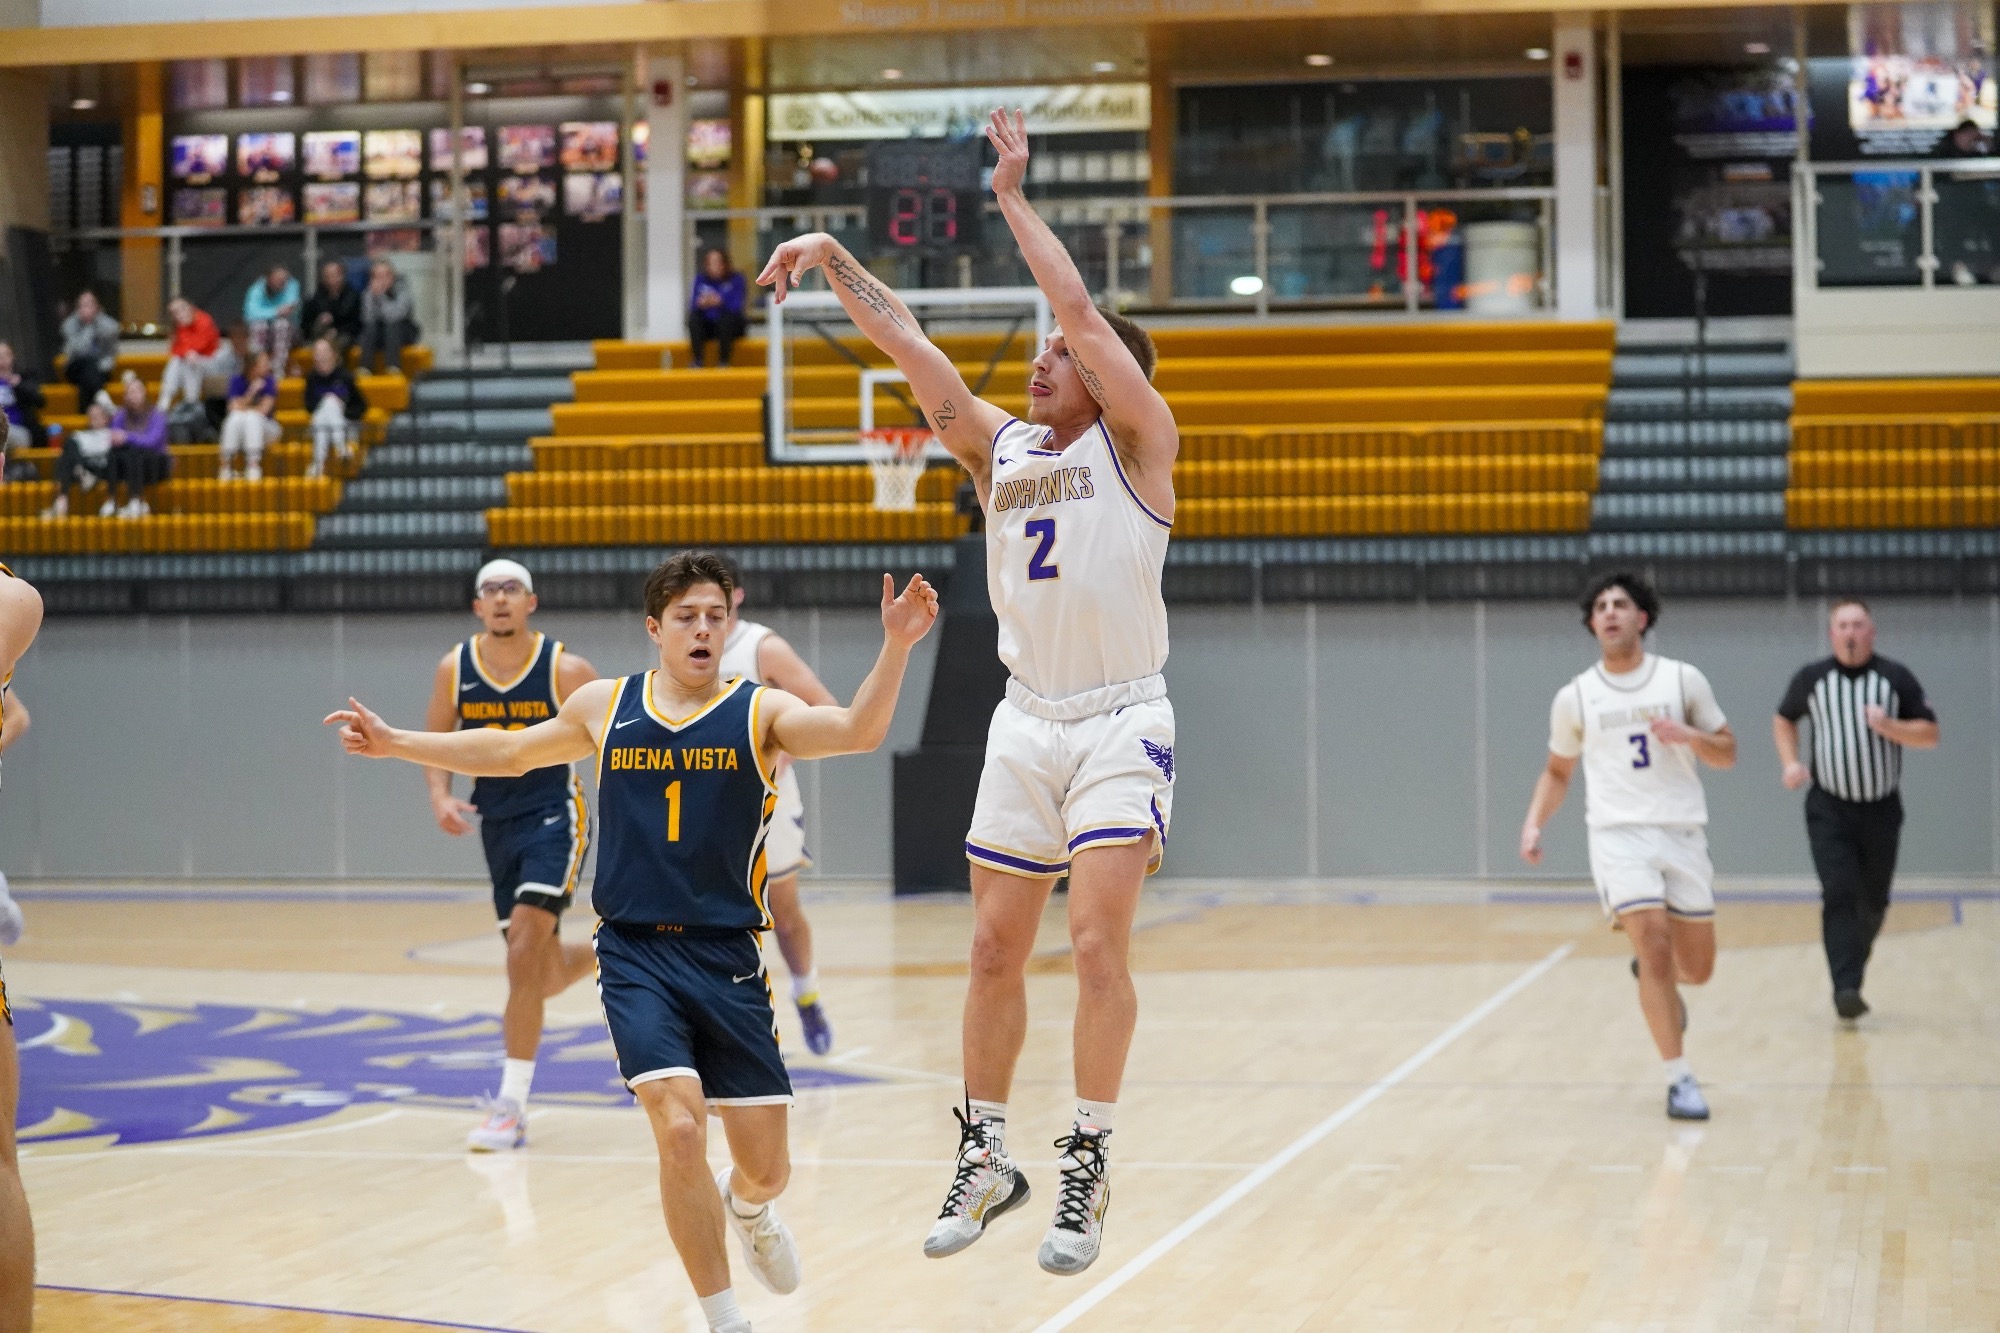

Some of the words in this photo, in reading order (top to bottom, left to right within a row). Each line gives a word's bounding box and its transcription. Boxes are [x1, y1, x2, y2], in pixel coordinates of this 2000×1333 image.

[1023, 516, 1061, 583] 2
[461, 701, 507, 719] BUENA
[508, 700, 550, 719] VISTA
[610, 747, 676, 771] BUENA
[681, 747, 739, 771] VISTA
[1628, 732, 1651, 769] 3
[665, 780, 682, 842] 1
